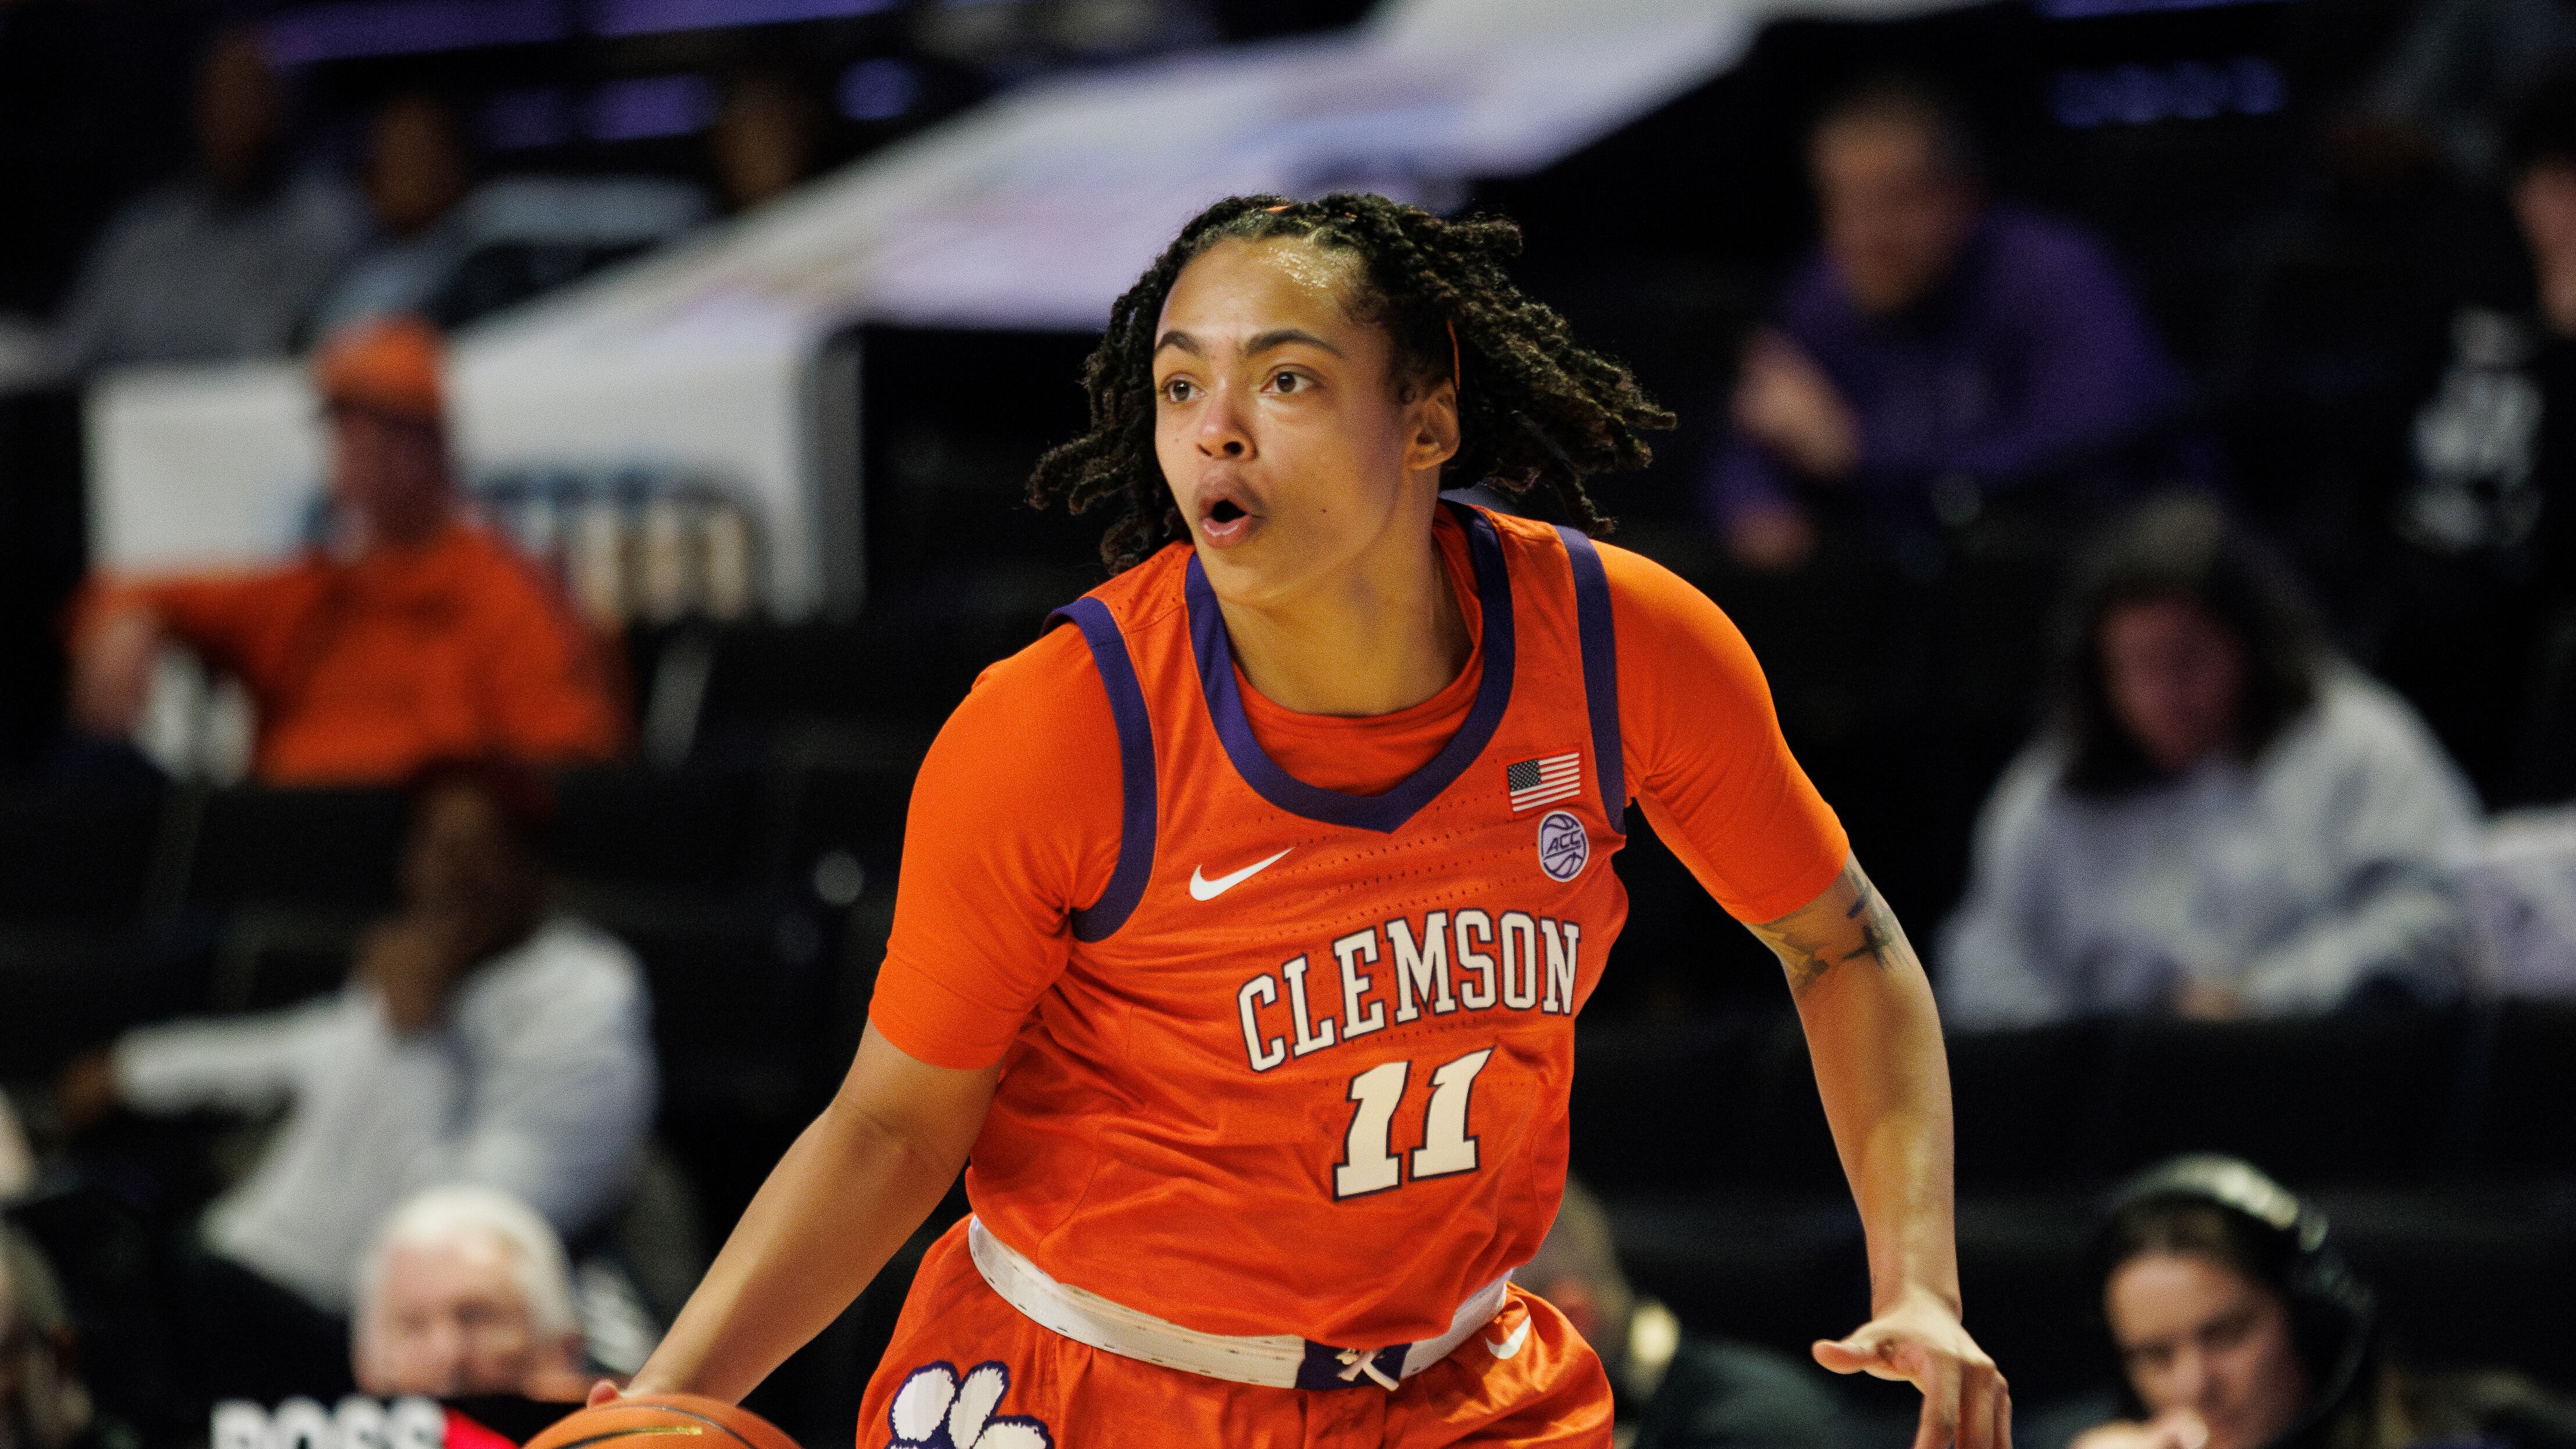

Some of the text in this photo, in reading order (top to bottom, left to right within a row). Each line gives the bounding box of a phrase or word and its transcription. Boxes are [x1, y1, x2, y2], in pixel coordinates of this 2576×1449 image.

[1546, 829, 1582, 855] ACC
[1236, 908, 1582, 1074] CLEMSON
[1332, 1045, 1497, 1201] 11
